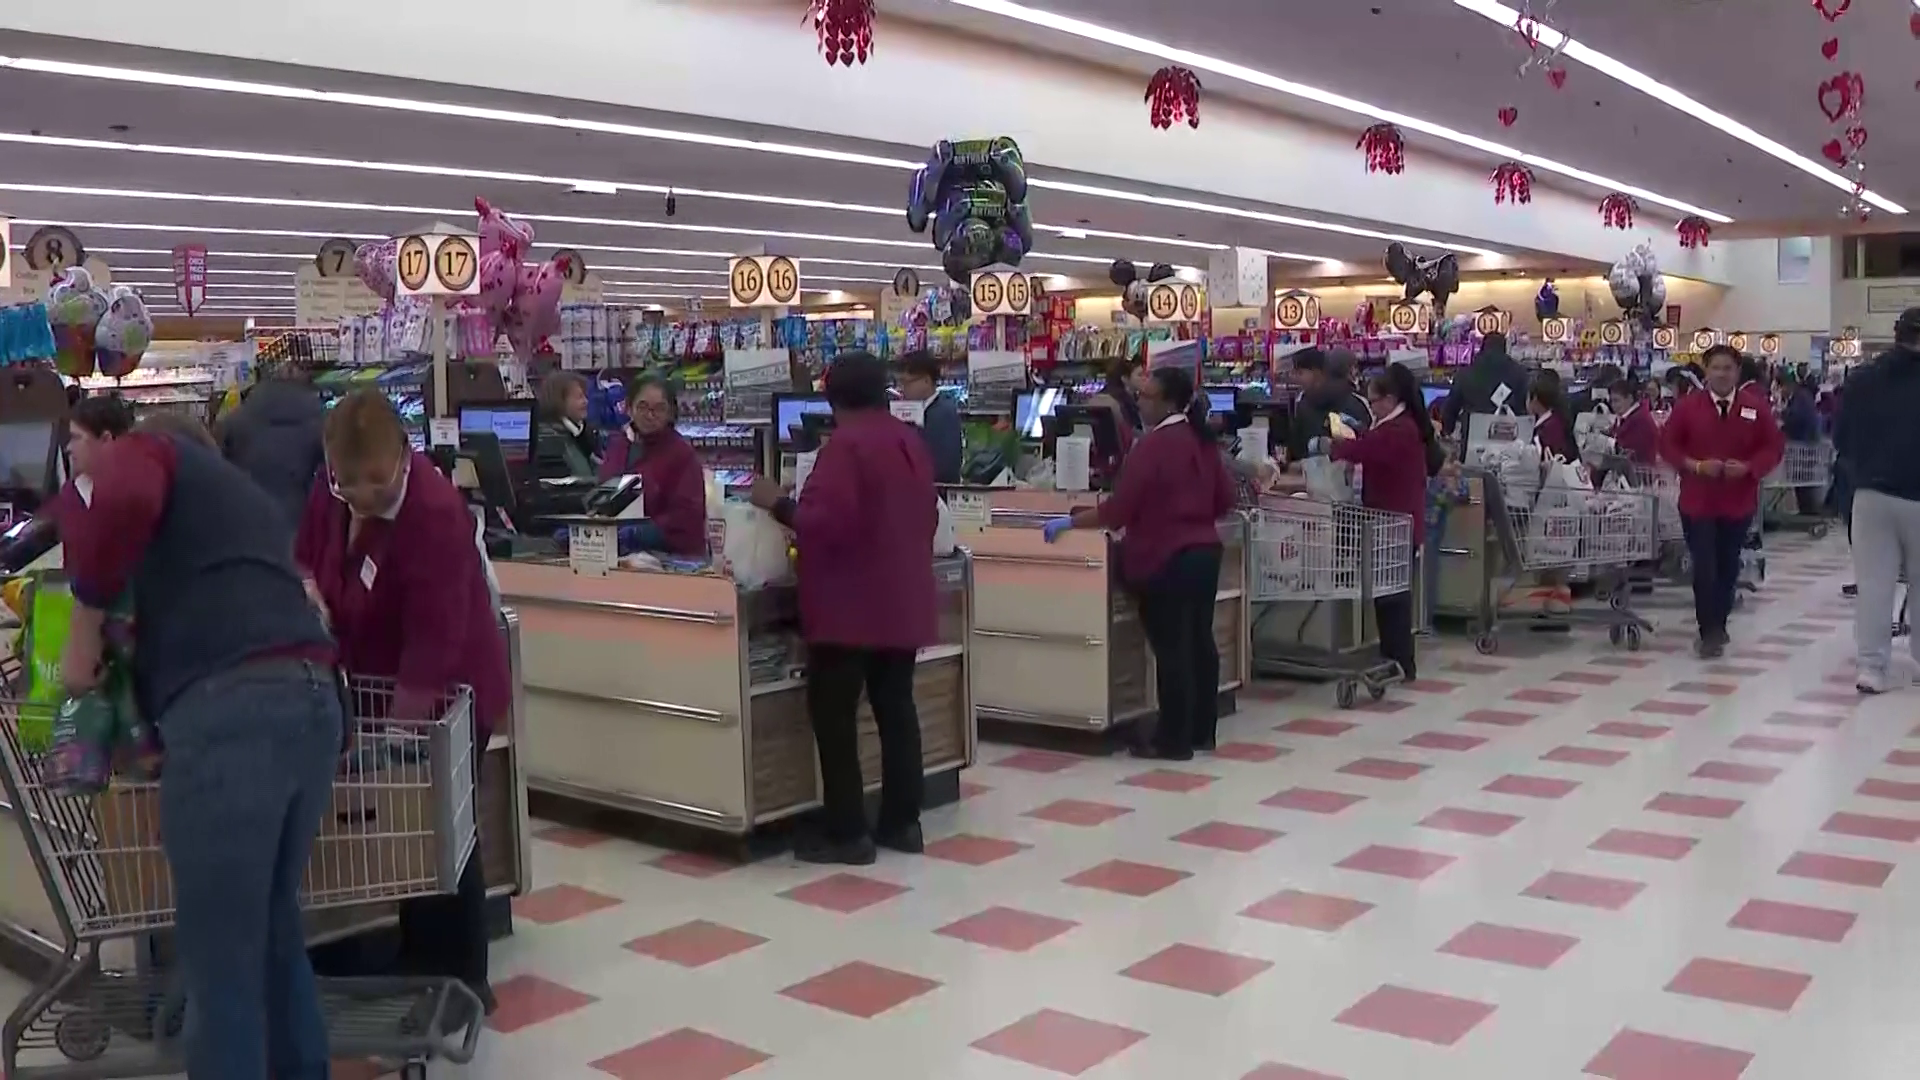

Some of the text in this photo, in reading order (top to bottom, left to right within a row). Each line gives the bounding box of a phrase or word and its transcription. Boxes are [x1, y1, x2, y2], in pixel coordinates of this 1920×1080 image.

[46, 239, 63, 264] 8
[333, 250, 345, 273] 7
[406, 250, 423, 276] 17
[444, 252, 468, 277] 17
[739, 268, 757, 292] 16
[774, 268, 792, 291] 16
[980, 284, 997, 302] 15
[1011, 284, 1024, 301] 15
[1156, 293, 1171, 310] 14
[1185, 294, 1194, 311] 14
[1283, 304, 1298, 319] 13
[1398, 311, 1412, 325] 12
[1482, 318, 1494, 330] 11
[1550, 324, 1561, 335] 10
[1608, 328, 1616, 339] 9
[1660, 332, 1666, 342] 8
